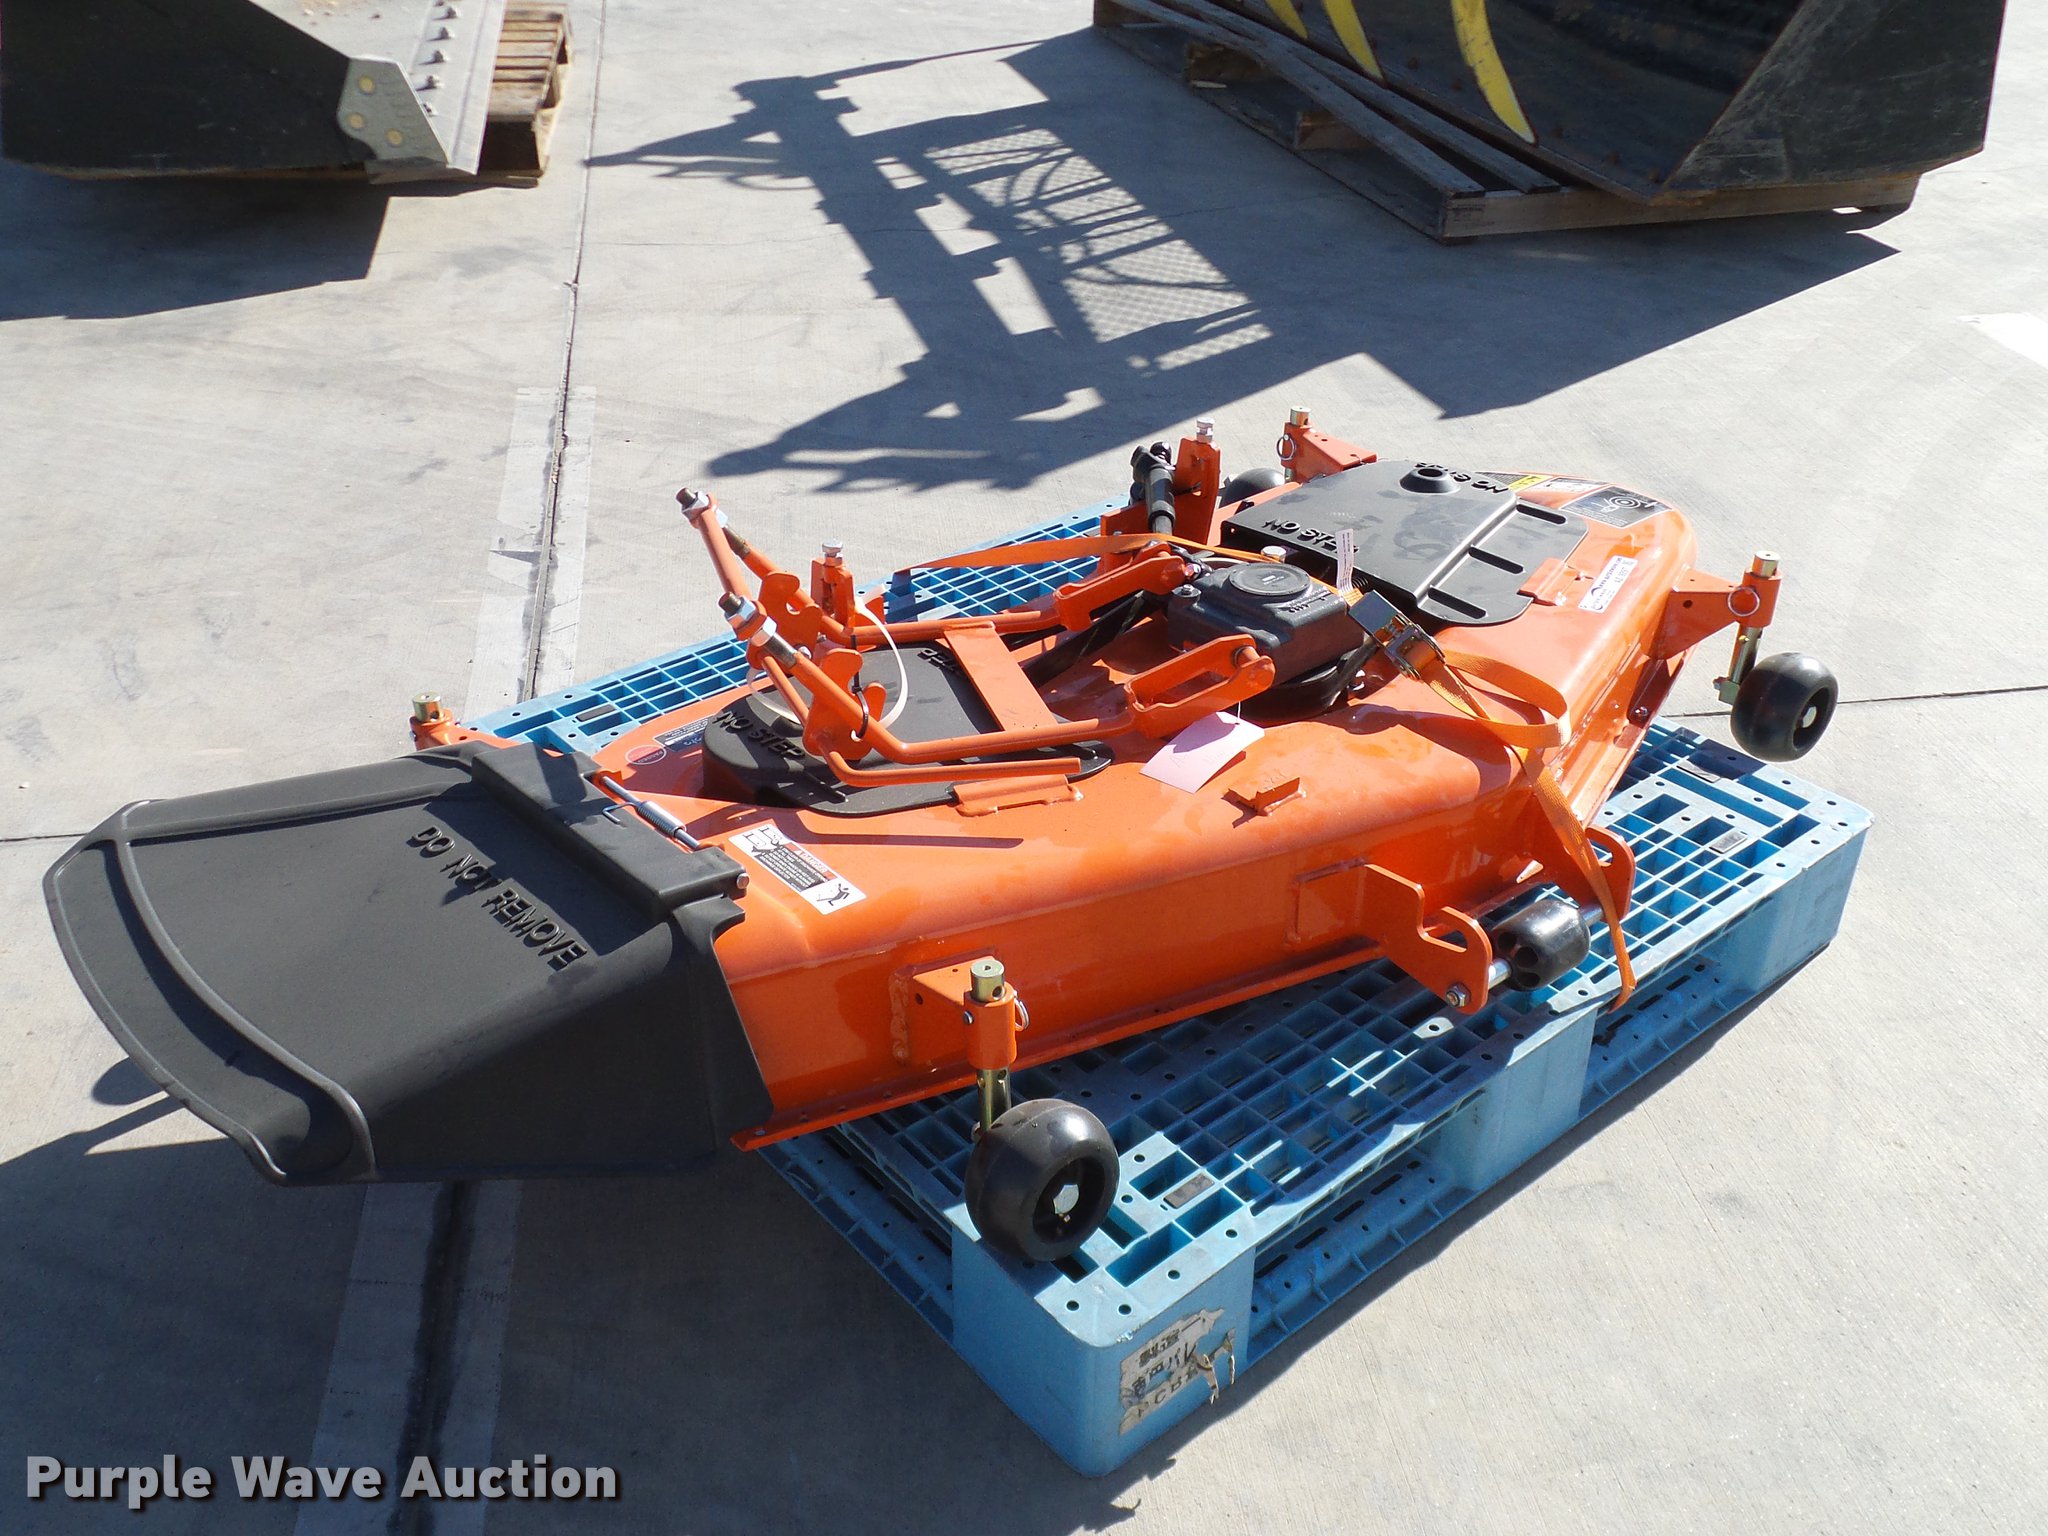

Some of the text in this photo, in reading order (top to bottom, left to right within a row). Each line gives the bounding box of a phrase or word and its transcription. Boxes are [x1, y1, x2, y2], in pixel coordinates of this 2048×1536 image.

[1261, 519, 1300, 533] NO
[712, 710, 750, 733] NO
[750, 728, 807, 758] STEP
[801, 850, 829, 874] DANGER
[411, 826, 588, 968] DO NOT REMOVE
